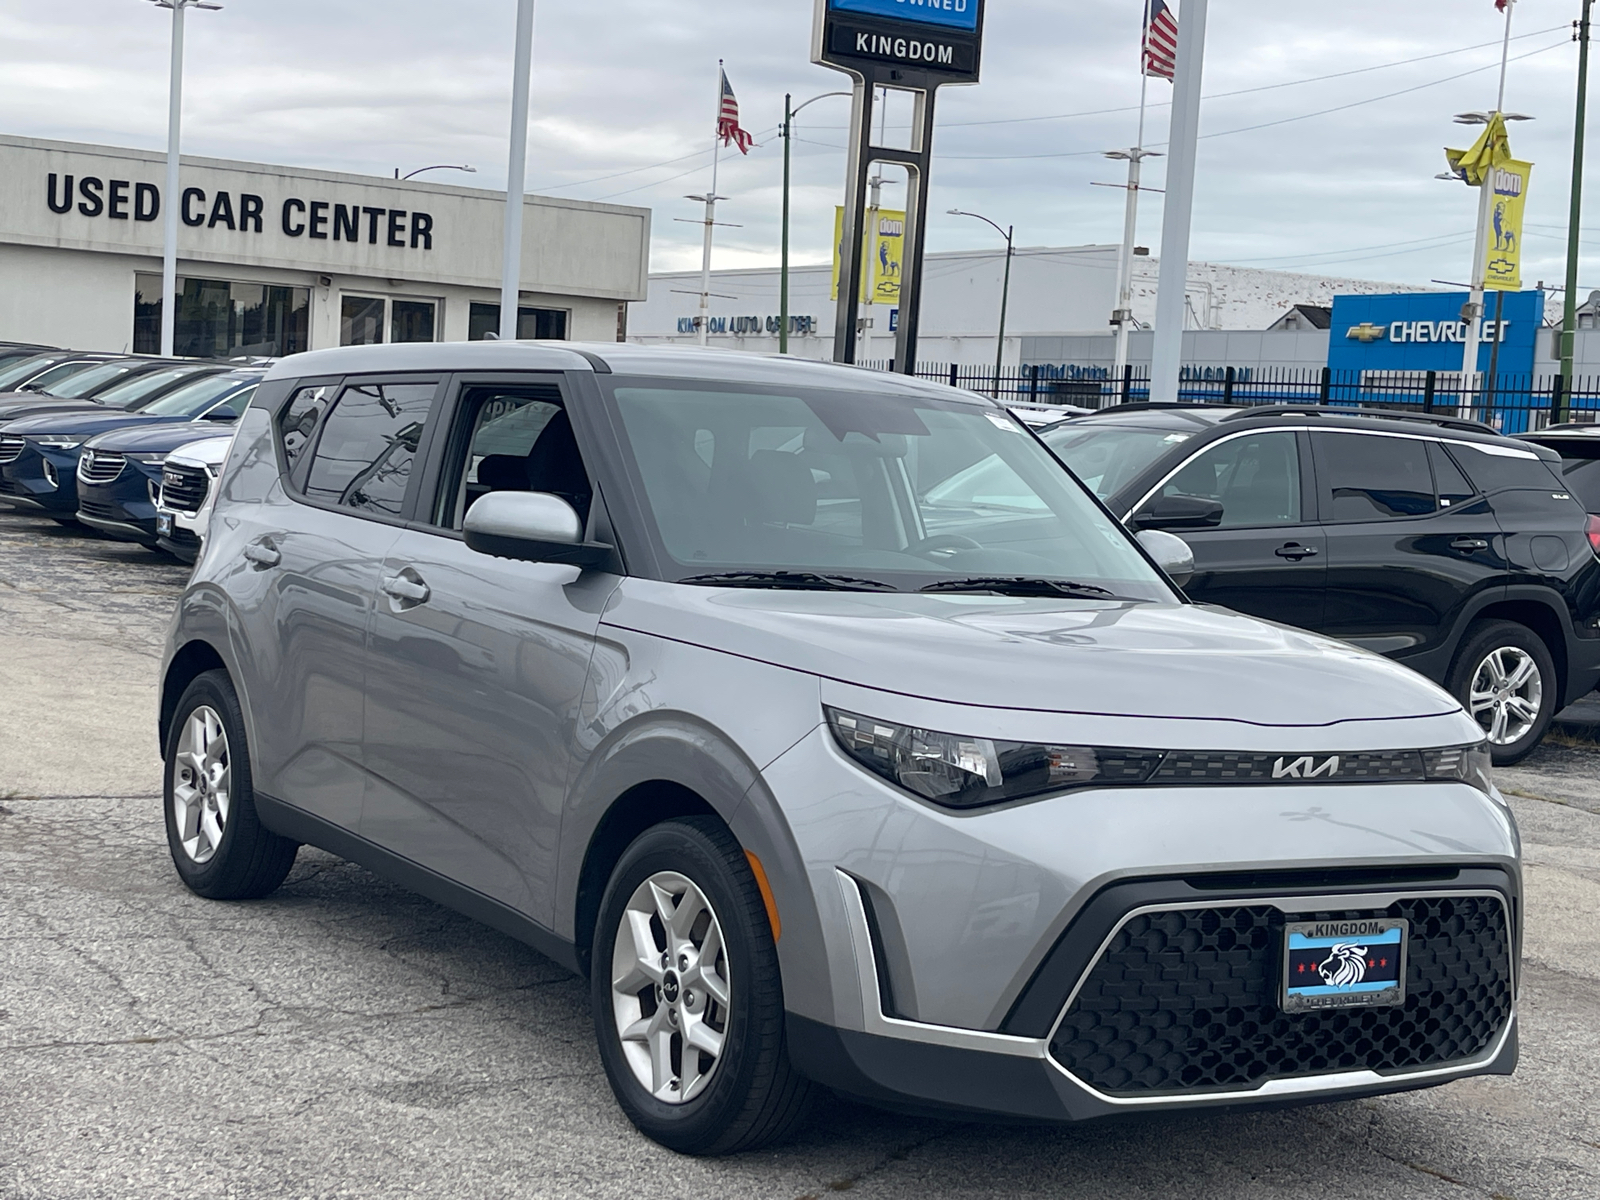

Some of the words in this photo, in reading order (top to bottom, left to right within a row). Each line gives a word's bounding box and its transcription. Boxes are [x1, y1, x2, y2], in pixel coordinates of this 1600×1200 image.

[896, 0, 967, 13] NED
[856, 32, 953, 64] KINGDOM
[1495, 167, 1522, 195] dom
[47, 173, 160, 222] USED
[181, 186, 264, 234] CAR
[282, 198, 434, 250] CENTER
[879, 217, 903, 235] dom
[677, 316, 726, 333] KINOM
[766, 315, 816, 333] CETER
[1389, 320, 1510, 343] CHEVROET
[1315, 922, 1379, 937] KINGDOM
